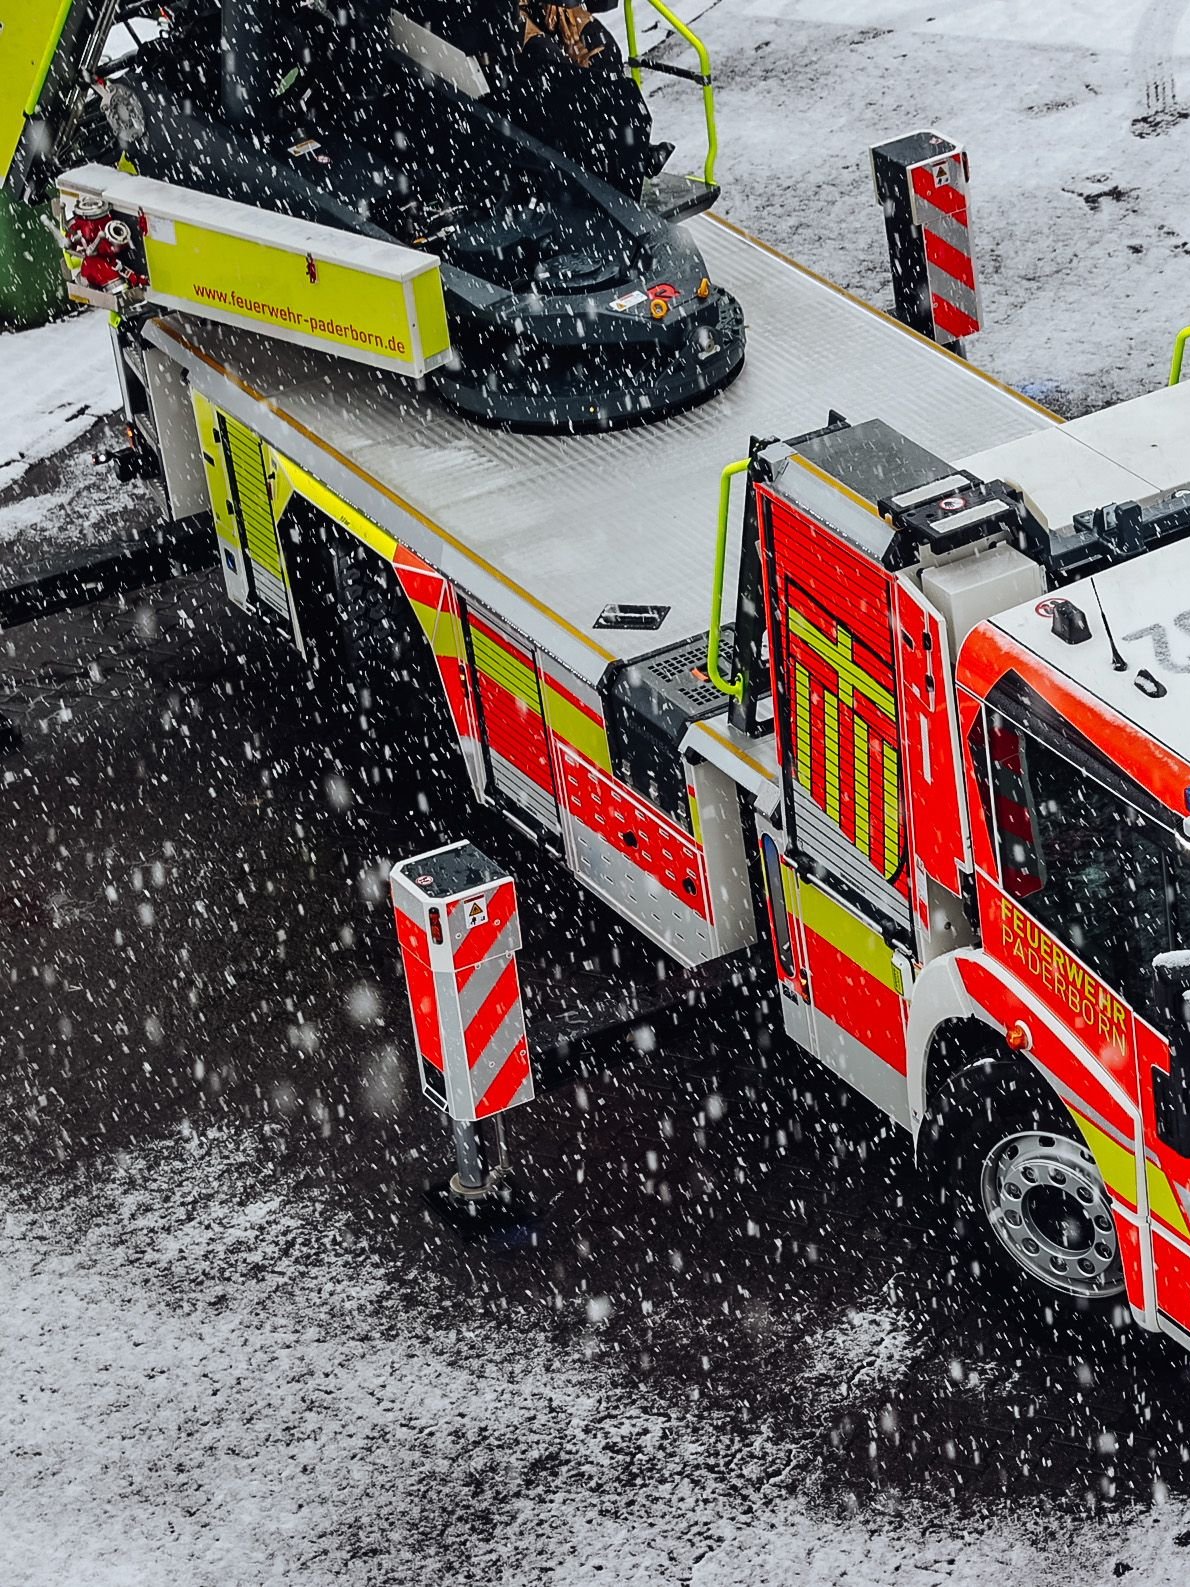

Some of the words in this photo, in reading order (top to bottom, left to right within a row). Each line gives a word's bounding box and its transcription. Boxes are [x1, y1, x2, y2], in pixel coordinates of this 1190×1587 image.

[193, 283, 406, 353] www.feuerwehr-paderborn.de
[1001, 897, 1127, 1033] FEUERWEHR
[1002, 924, 1126, 1057] PADERBORN
